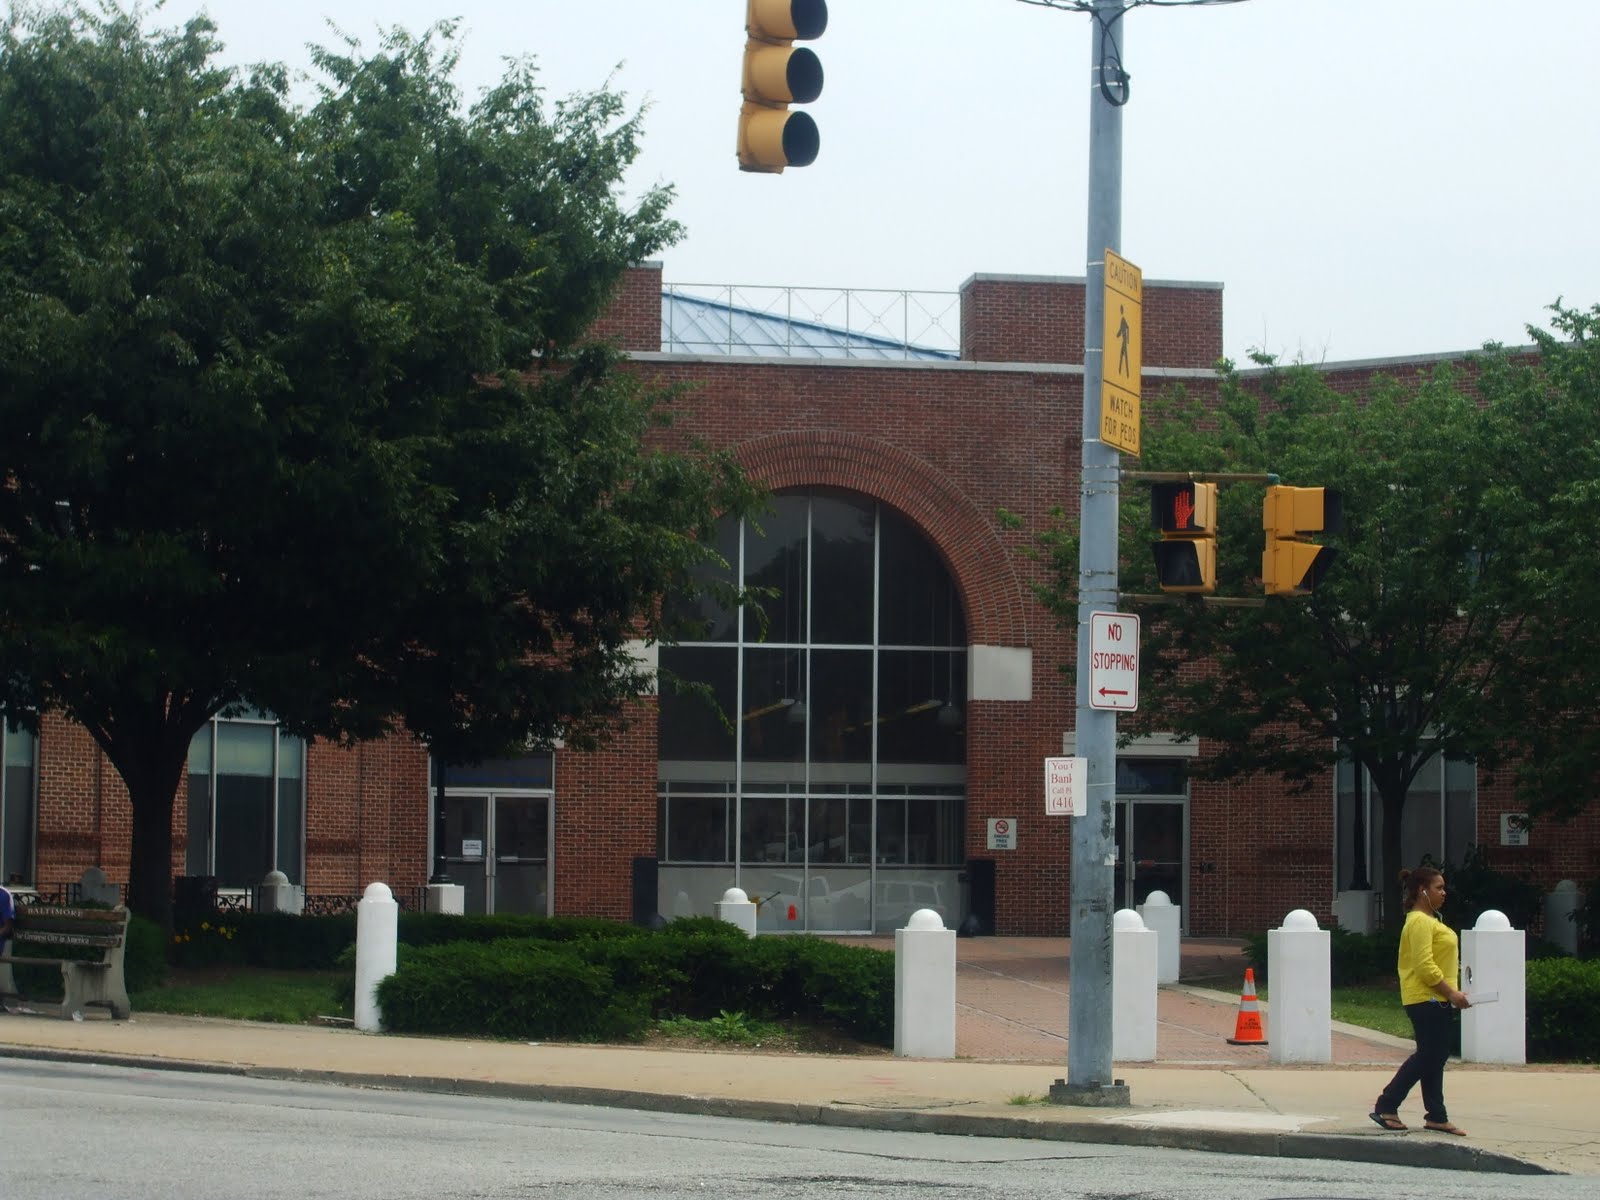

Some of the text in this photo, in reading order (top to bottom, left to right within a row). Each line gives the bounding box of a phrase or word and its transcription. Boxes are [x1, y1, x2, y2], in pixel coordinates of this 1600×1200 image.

[1110, 261, 1138, 292] CAUTION
[1110, 395, 1133, 419] WATCH
[1105, 416, 1136, 445] FOR PEDS
[1108, 623, 1122, 641] NO
[1093, 652, 1135, 671] STOPPING
[1052, 762, 1068, 770] You
[27, 907, 84, 917] BALTIMORE
[47, 935, 58, 943] City
[67, 936, 90, 945] America
